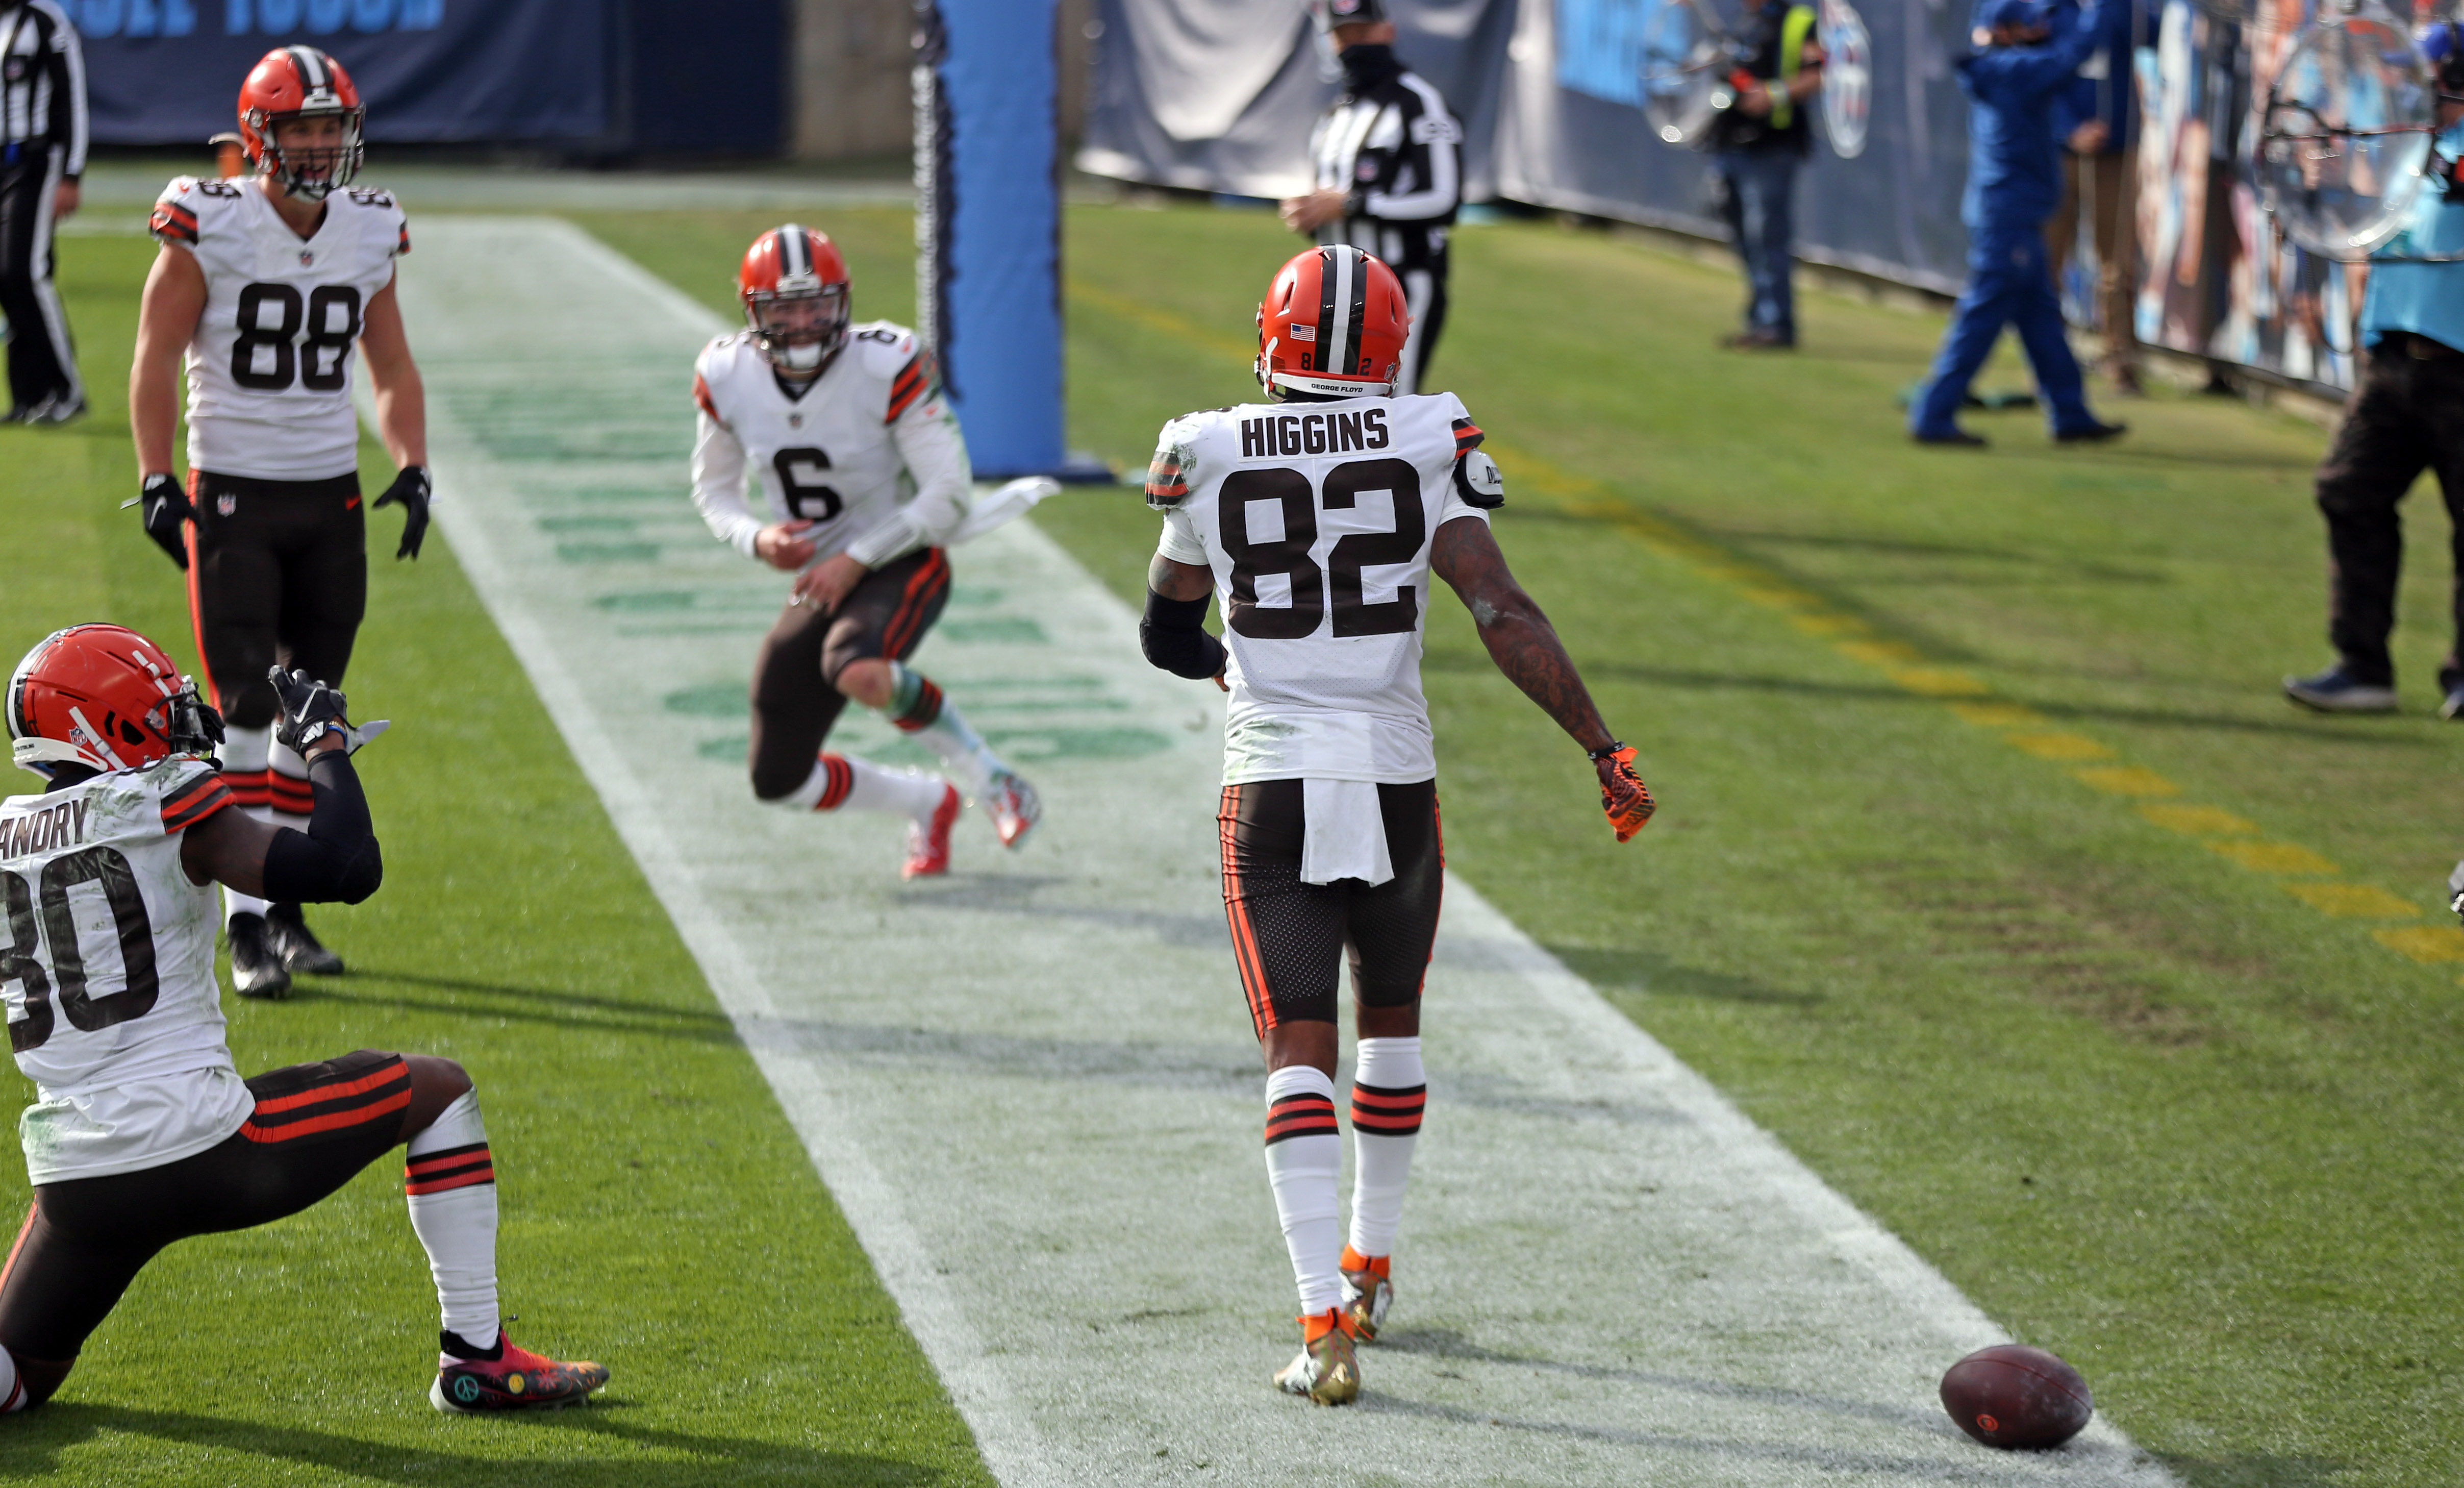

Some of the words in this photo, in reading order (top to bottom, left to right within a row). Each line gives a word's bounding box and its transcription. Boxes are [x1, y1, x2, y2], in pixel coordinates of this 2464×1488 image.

[231, 283, 361, 391] 88
[1301, 353, 1312, 370] 8
[1360, 358, 1371, 376] 2
[1311, 383, 1340, 391] GEORGE
[1241, 408, 1389, 457] HIGGINS
[773, 447, 844, 523] 6
[1218, 458, 1426, 639] 82
